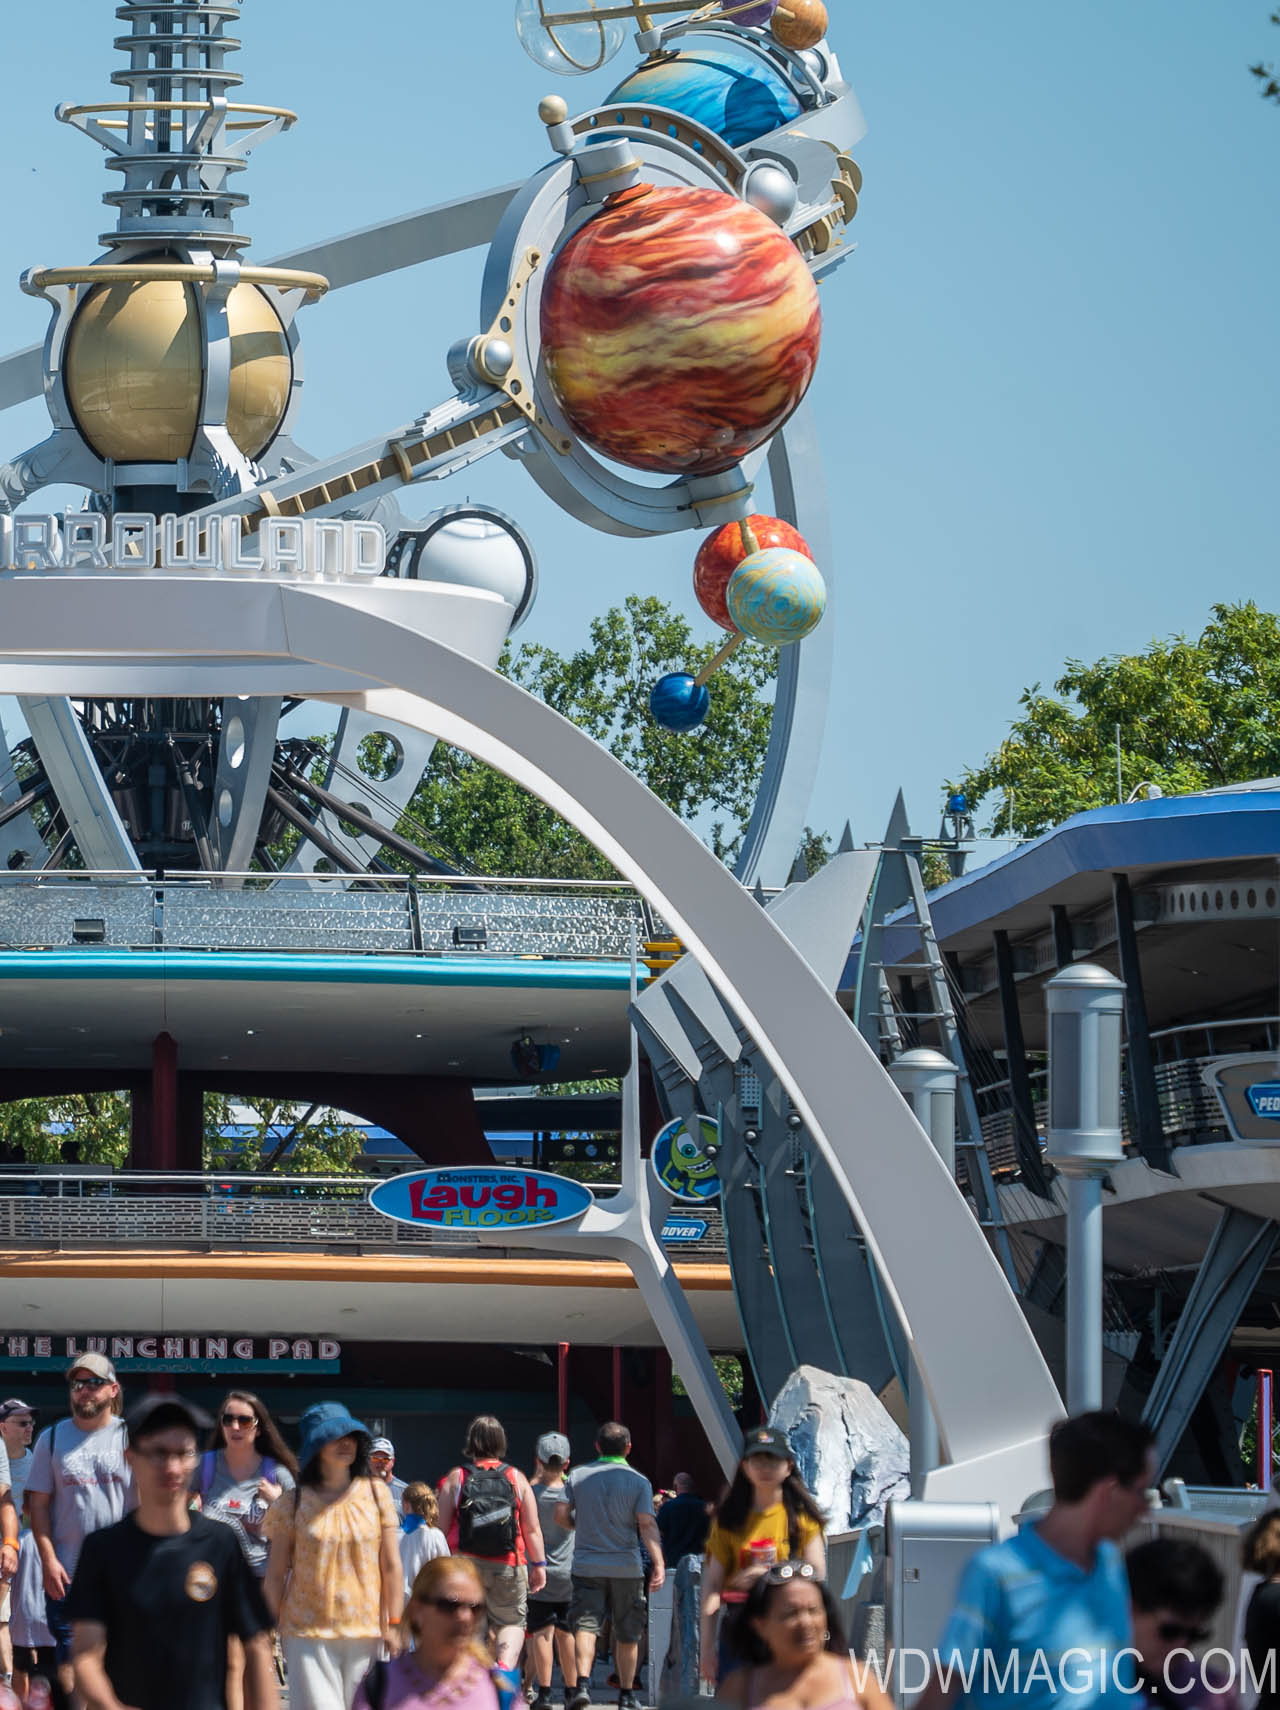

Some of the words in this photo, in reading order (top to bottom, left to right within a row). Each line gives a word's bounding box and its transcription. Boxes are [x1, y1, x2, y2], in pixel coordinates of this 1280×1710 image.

[409, 1176, 557, 1222] Laugh
[445, 1209, 555, 1226] FLOOR
[66, 1336, 254, 1360] LUNCHING
[269, 1338, 341, 1360] PAD
